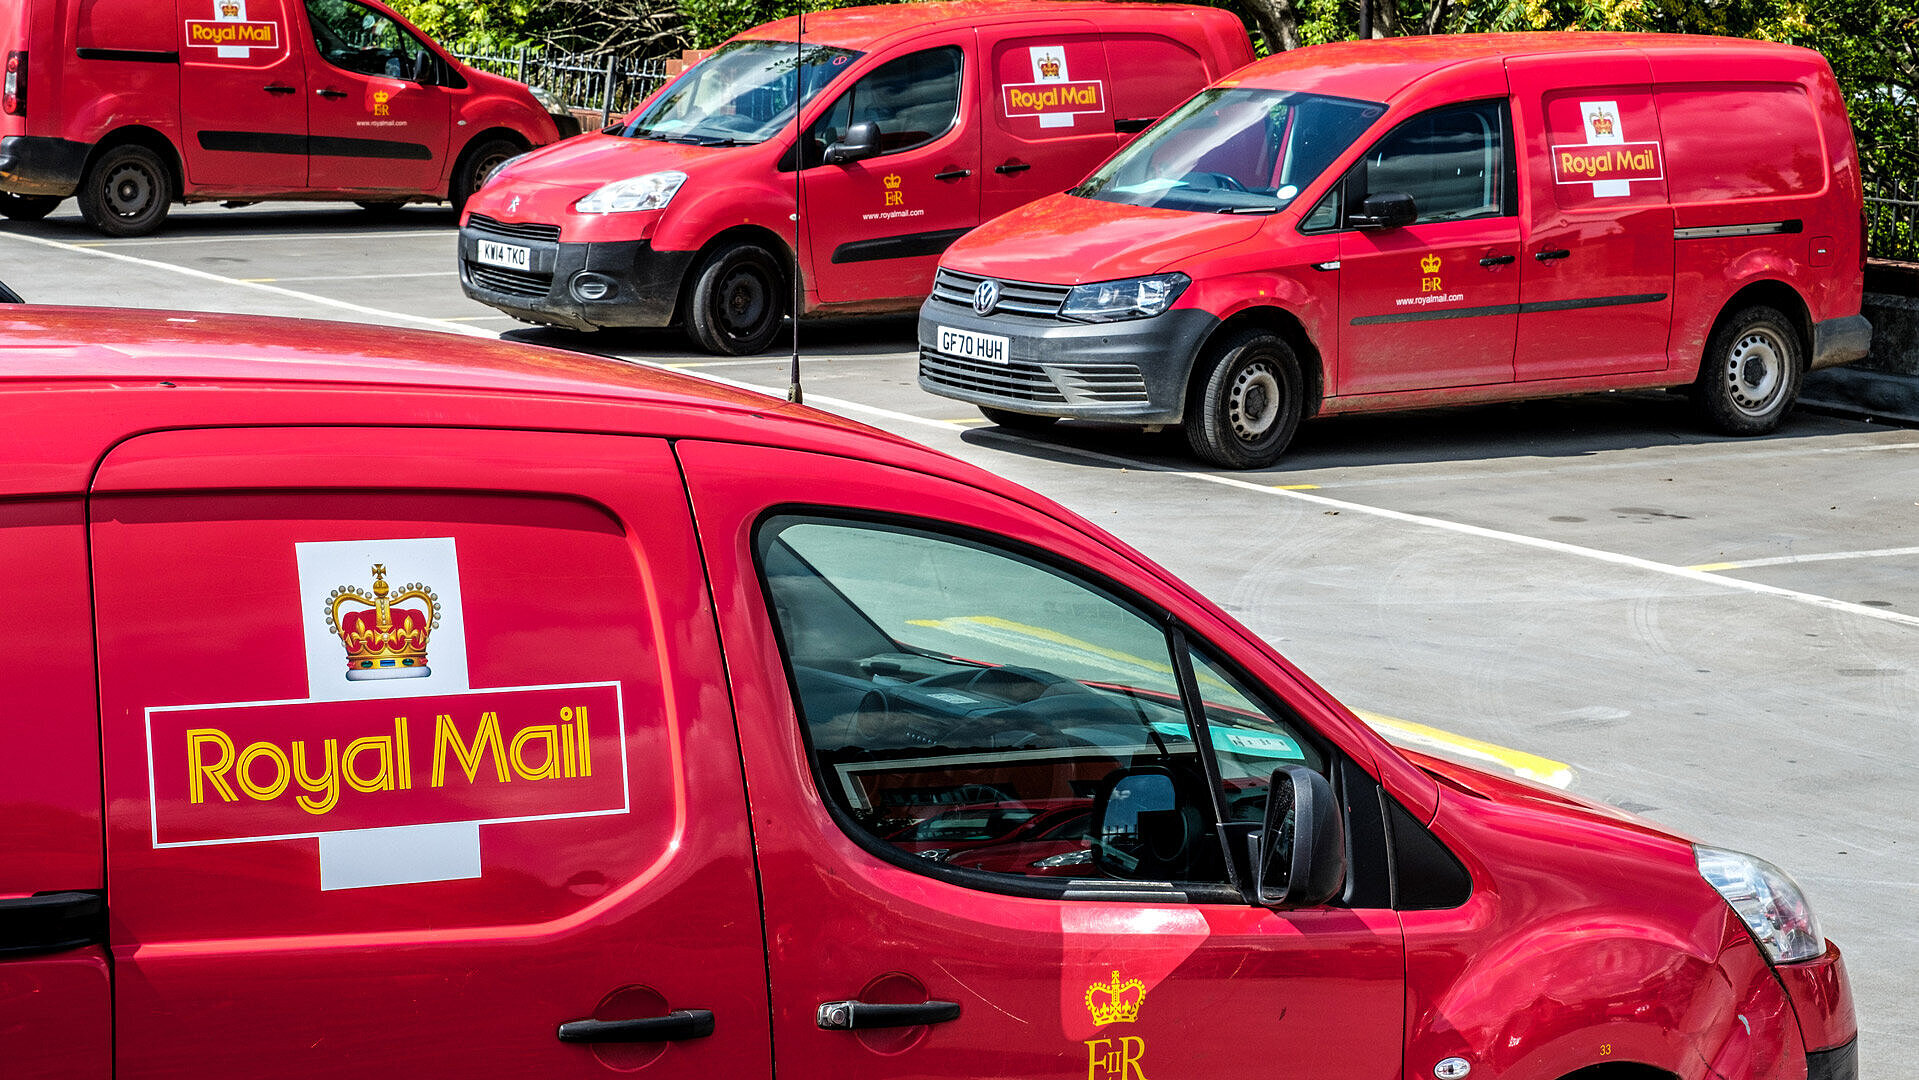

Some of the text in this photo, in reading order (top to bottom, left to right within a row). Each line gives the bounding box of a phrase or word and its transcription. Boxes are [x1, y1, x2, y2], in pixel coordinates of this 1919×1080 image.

[192, 24, 271, 43] Royal Mail
[1010, 86, 1096, 110] Royal Mail
[1561, 149, 1655, 177] Royal Mail
[862, 209, 924, 220] www.royalmail.com
[1395, 293, 1464, 306] www.royalmail.com
[943, 331, 1003, 361] GF70 HUH
[186, 706, 592, 815] Royal Mail
[1599, 1044, 1611, 1056] 33
